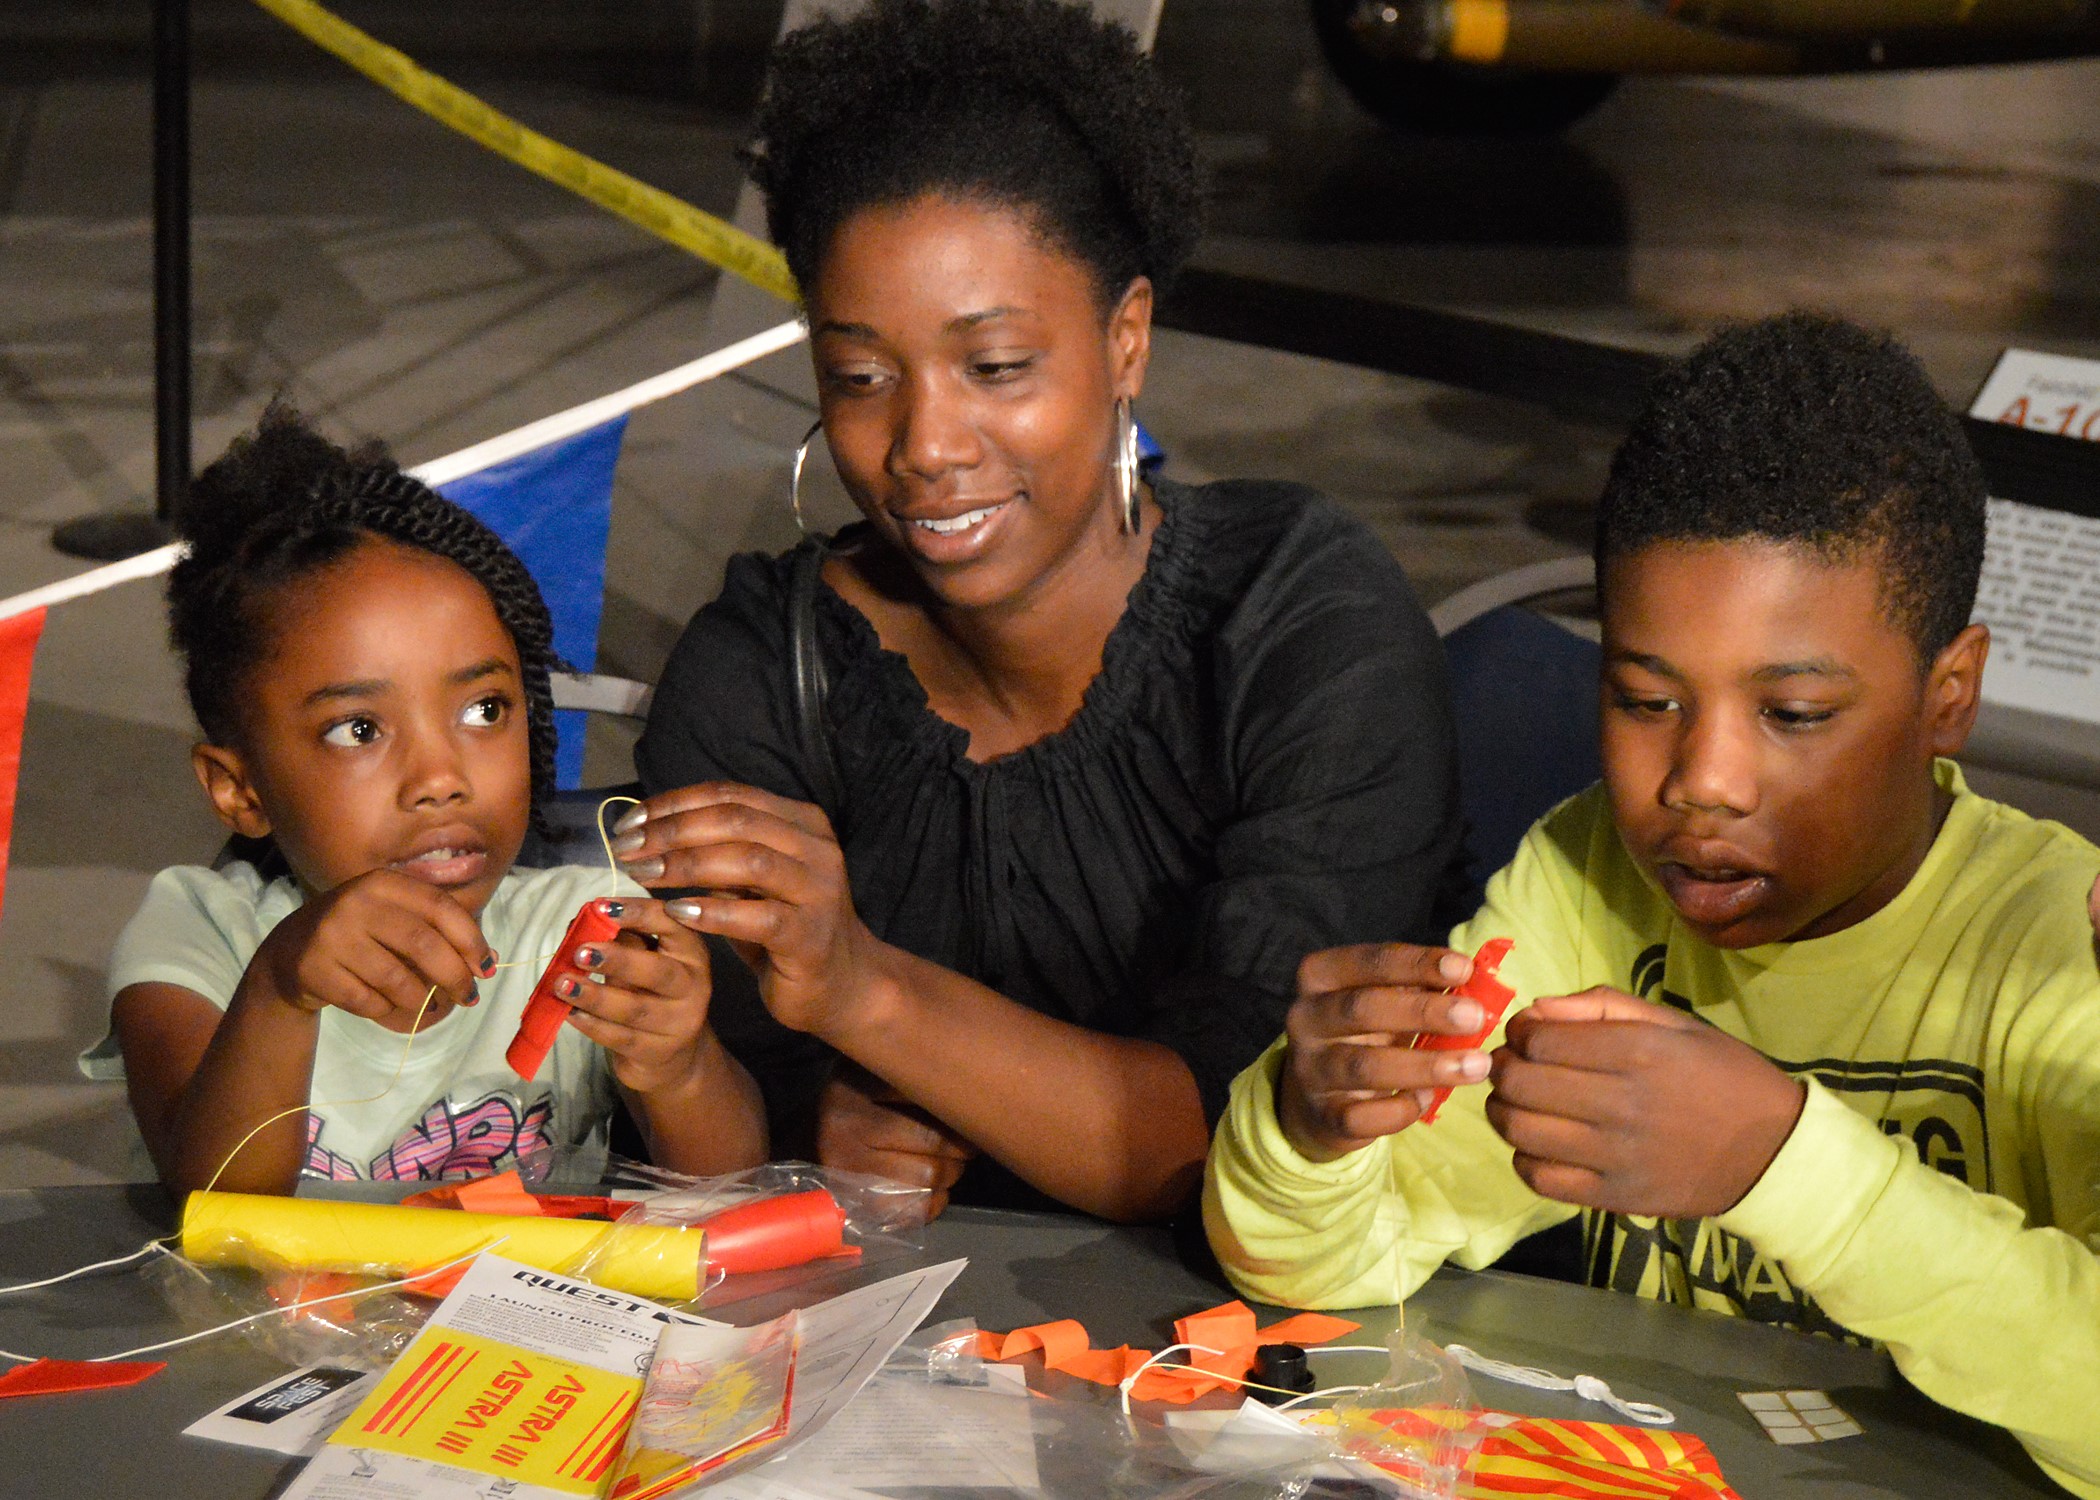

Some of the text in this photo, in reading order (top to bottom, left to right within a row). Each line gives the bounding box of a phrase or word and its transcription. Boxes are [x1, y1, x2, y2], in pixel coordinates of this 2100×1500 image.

[513, 1270, 649, 1313] QUEST
[254, 1376, 323, 1410] SPACE
[276, 1383, 331, 1411] FEST
[454, 1359, 534, 1429] ASTRA
[507, 1373, 587, 1443] ASTRA
